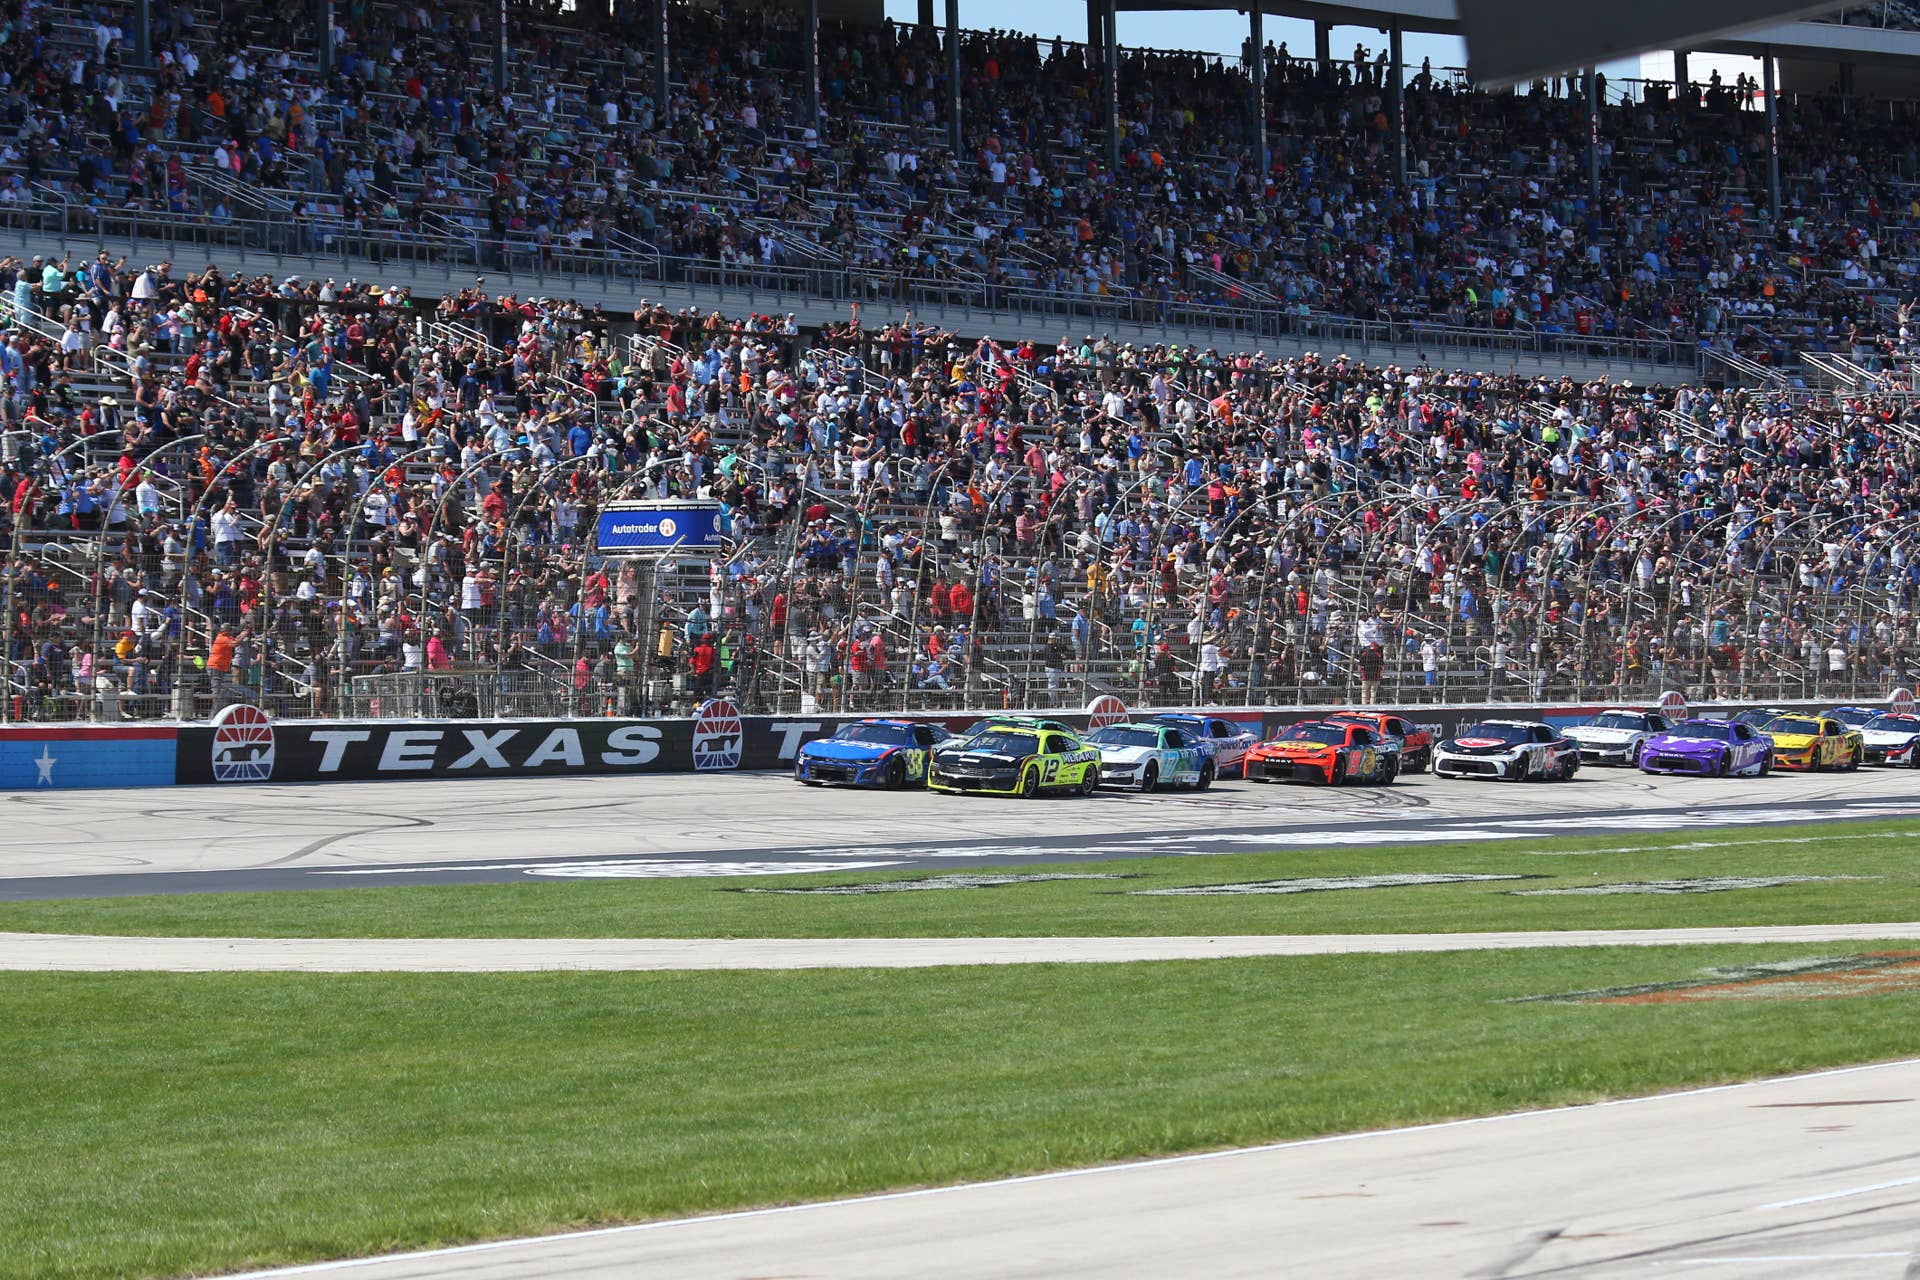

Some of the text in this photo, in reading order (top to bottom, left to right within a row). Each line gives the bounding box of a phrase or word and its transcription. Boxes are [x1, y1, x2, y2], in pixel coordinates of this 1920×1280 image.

[612, 522, 658, 534] Autotrader
[309, 726, 663, 772] TEXAS
[907, 748, 924, 774] 33
[1041, 759, 1060, 783] 12
[1161, 751, 1179, 777] 17
